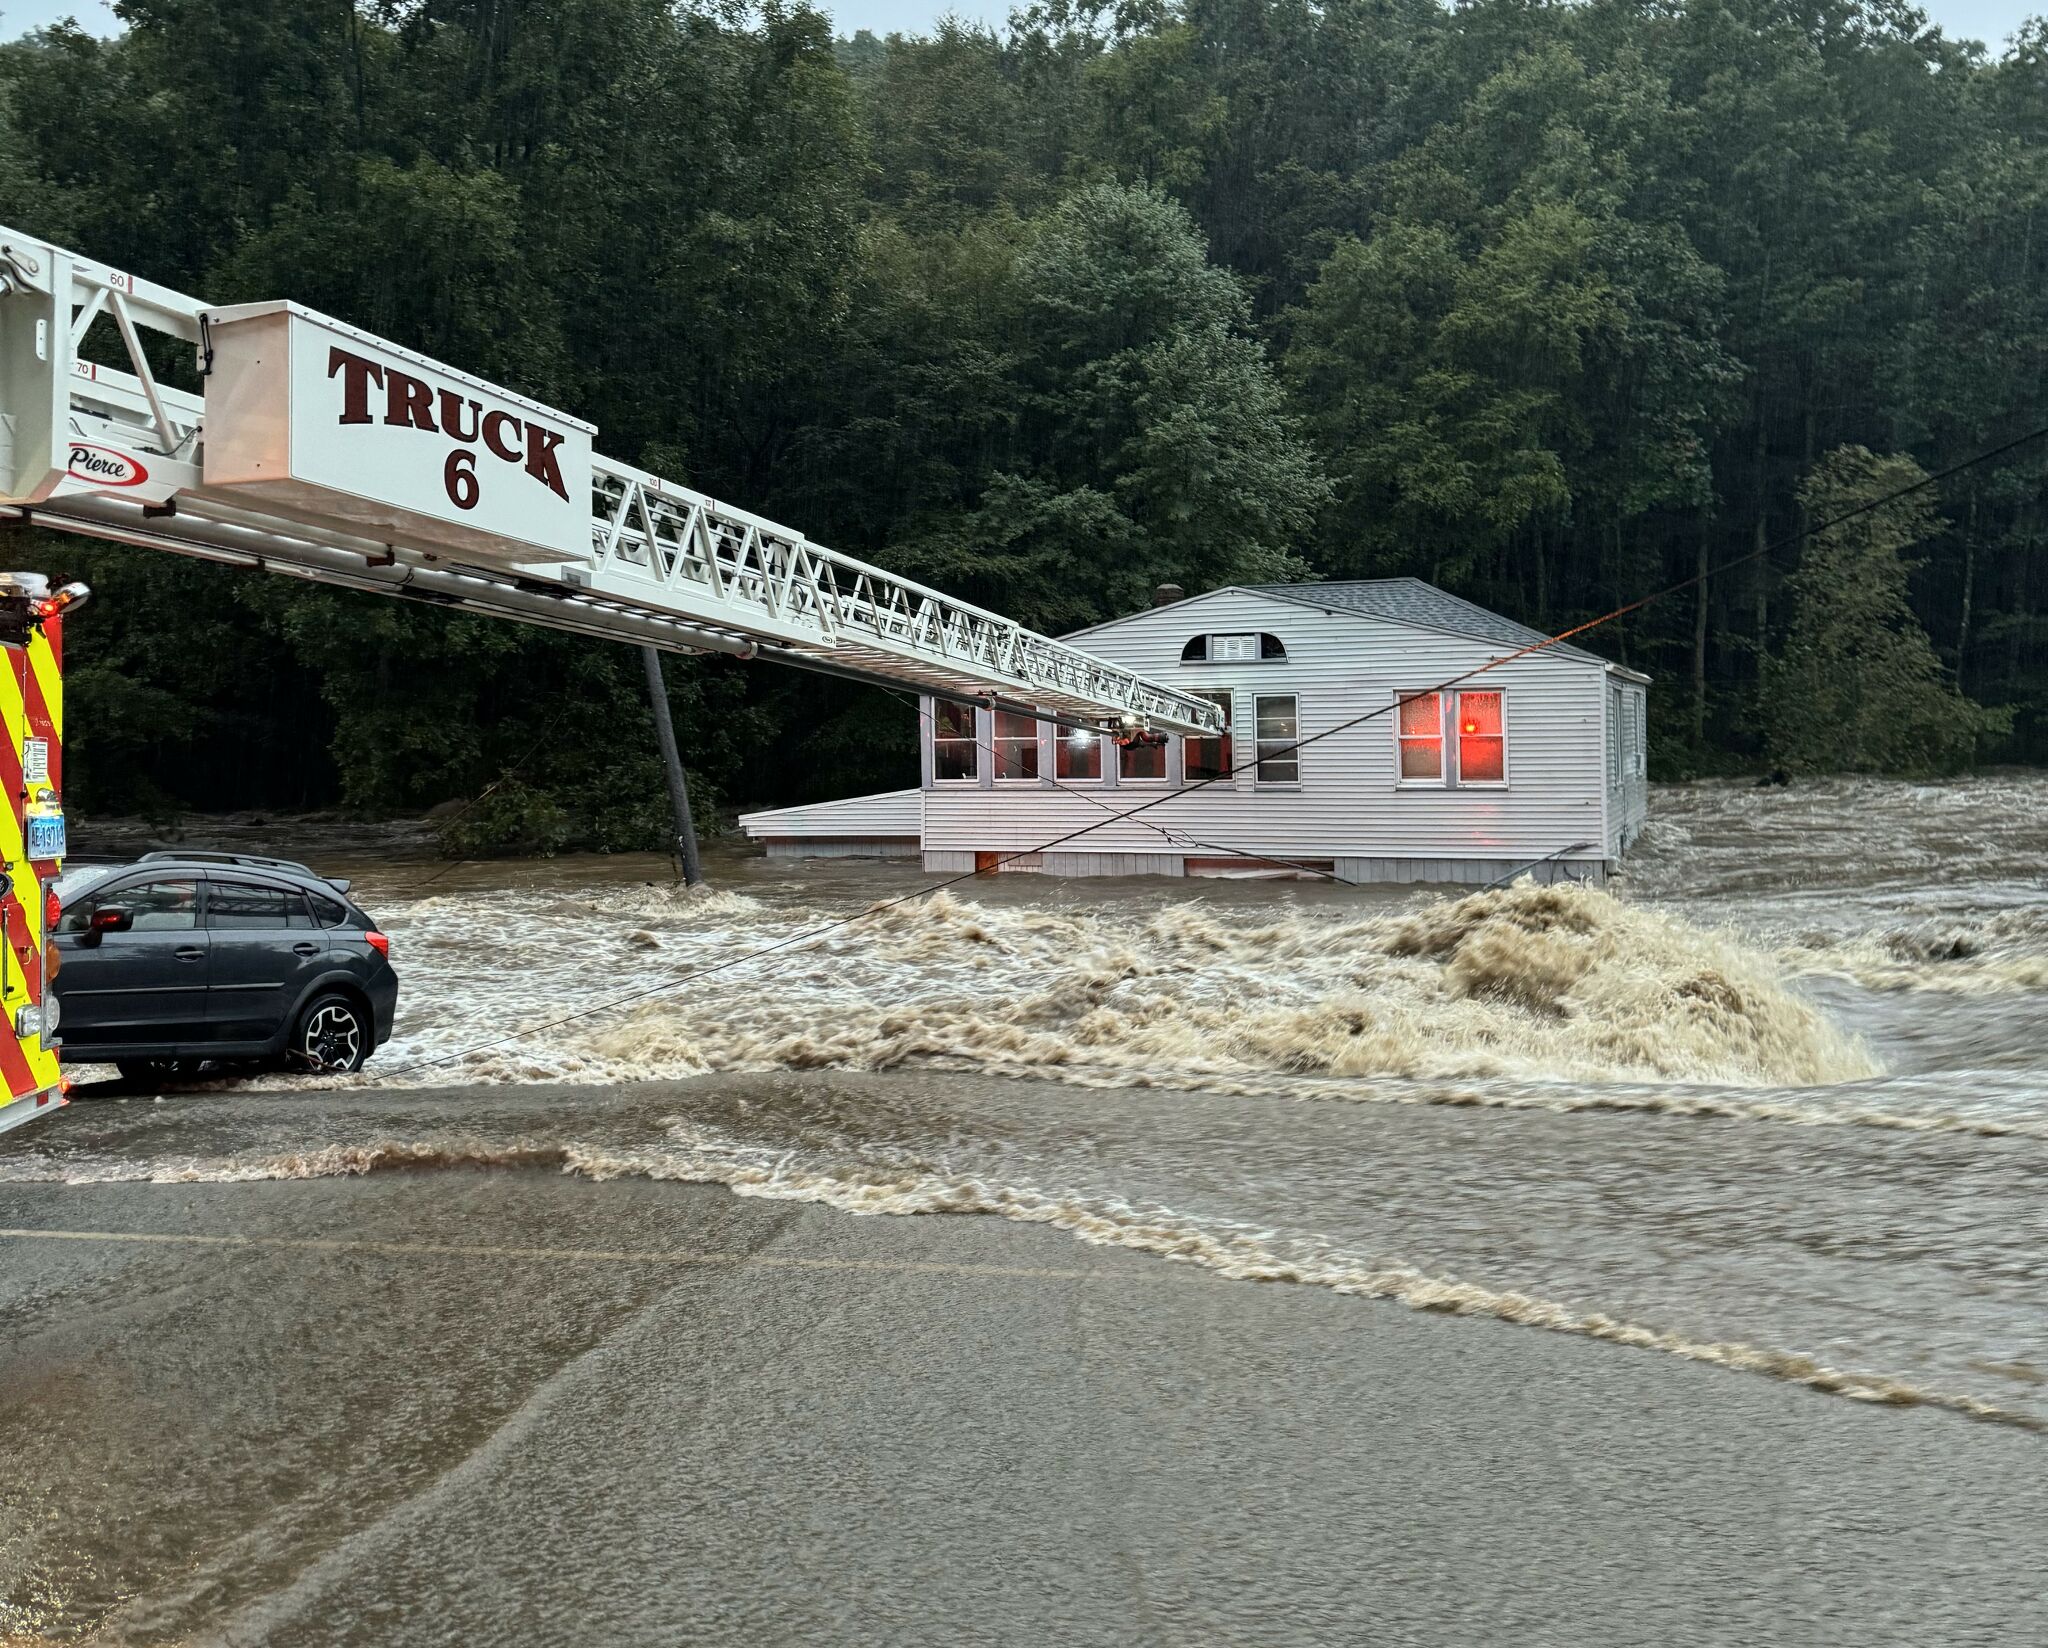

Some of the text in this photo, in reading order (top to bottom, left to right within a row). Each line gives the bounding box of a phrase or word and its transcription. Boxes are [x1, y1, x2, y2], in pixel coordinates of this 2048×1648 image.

[110, 273, 125, 288] 60
[77, 362, 89, 375] 70
[327, 345, 570, 504] TRUCK
[68, 447, 126, 477] Pierce
[444, 448, 480, 510] 6
